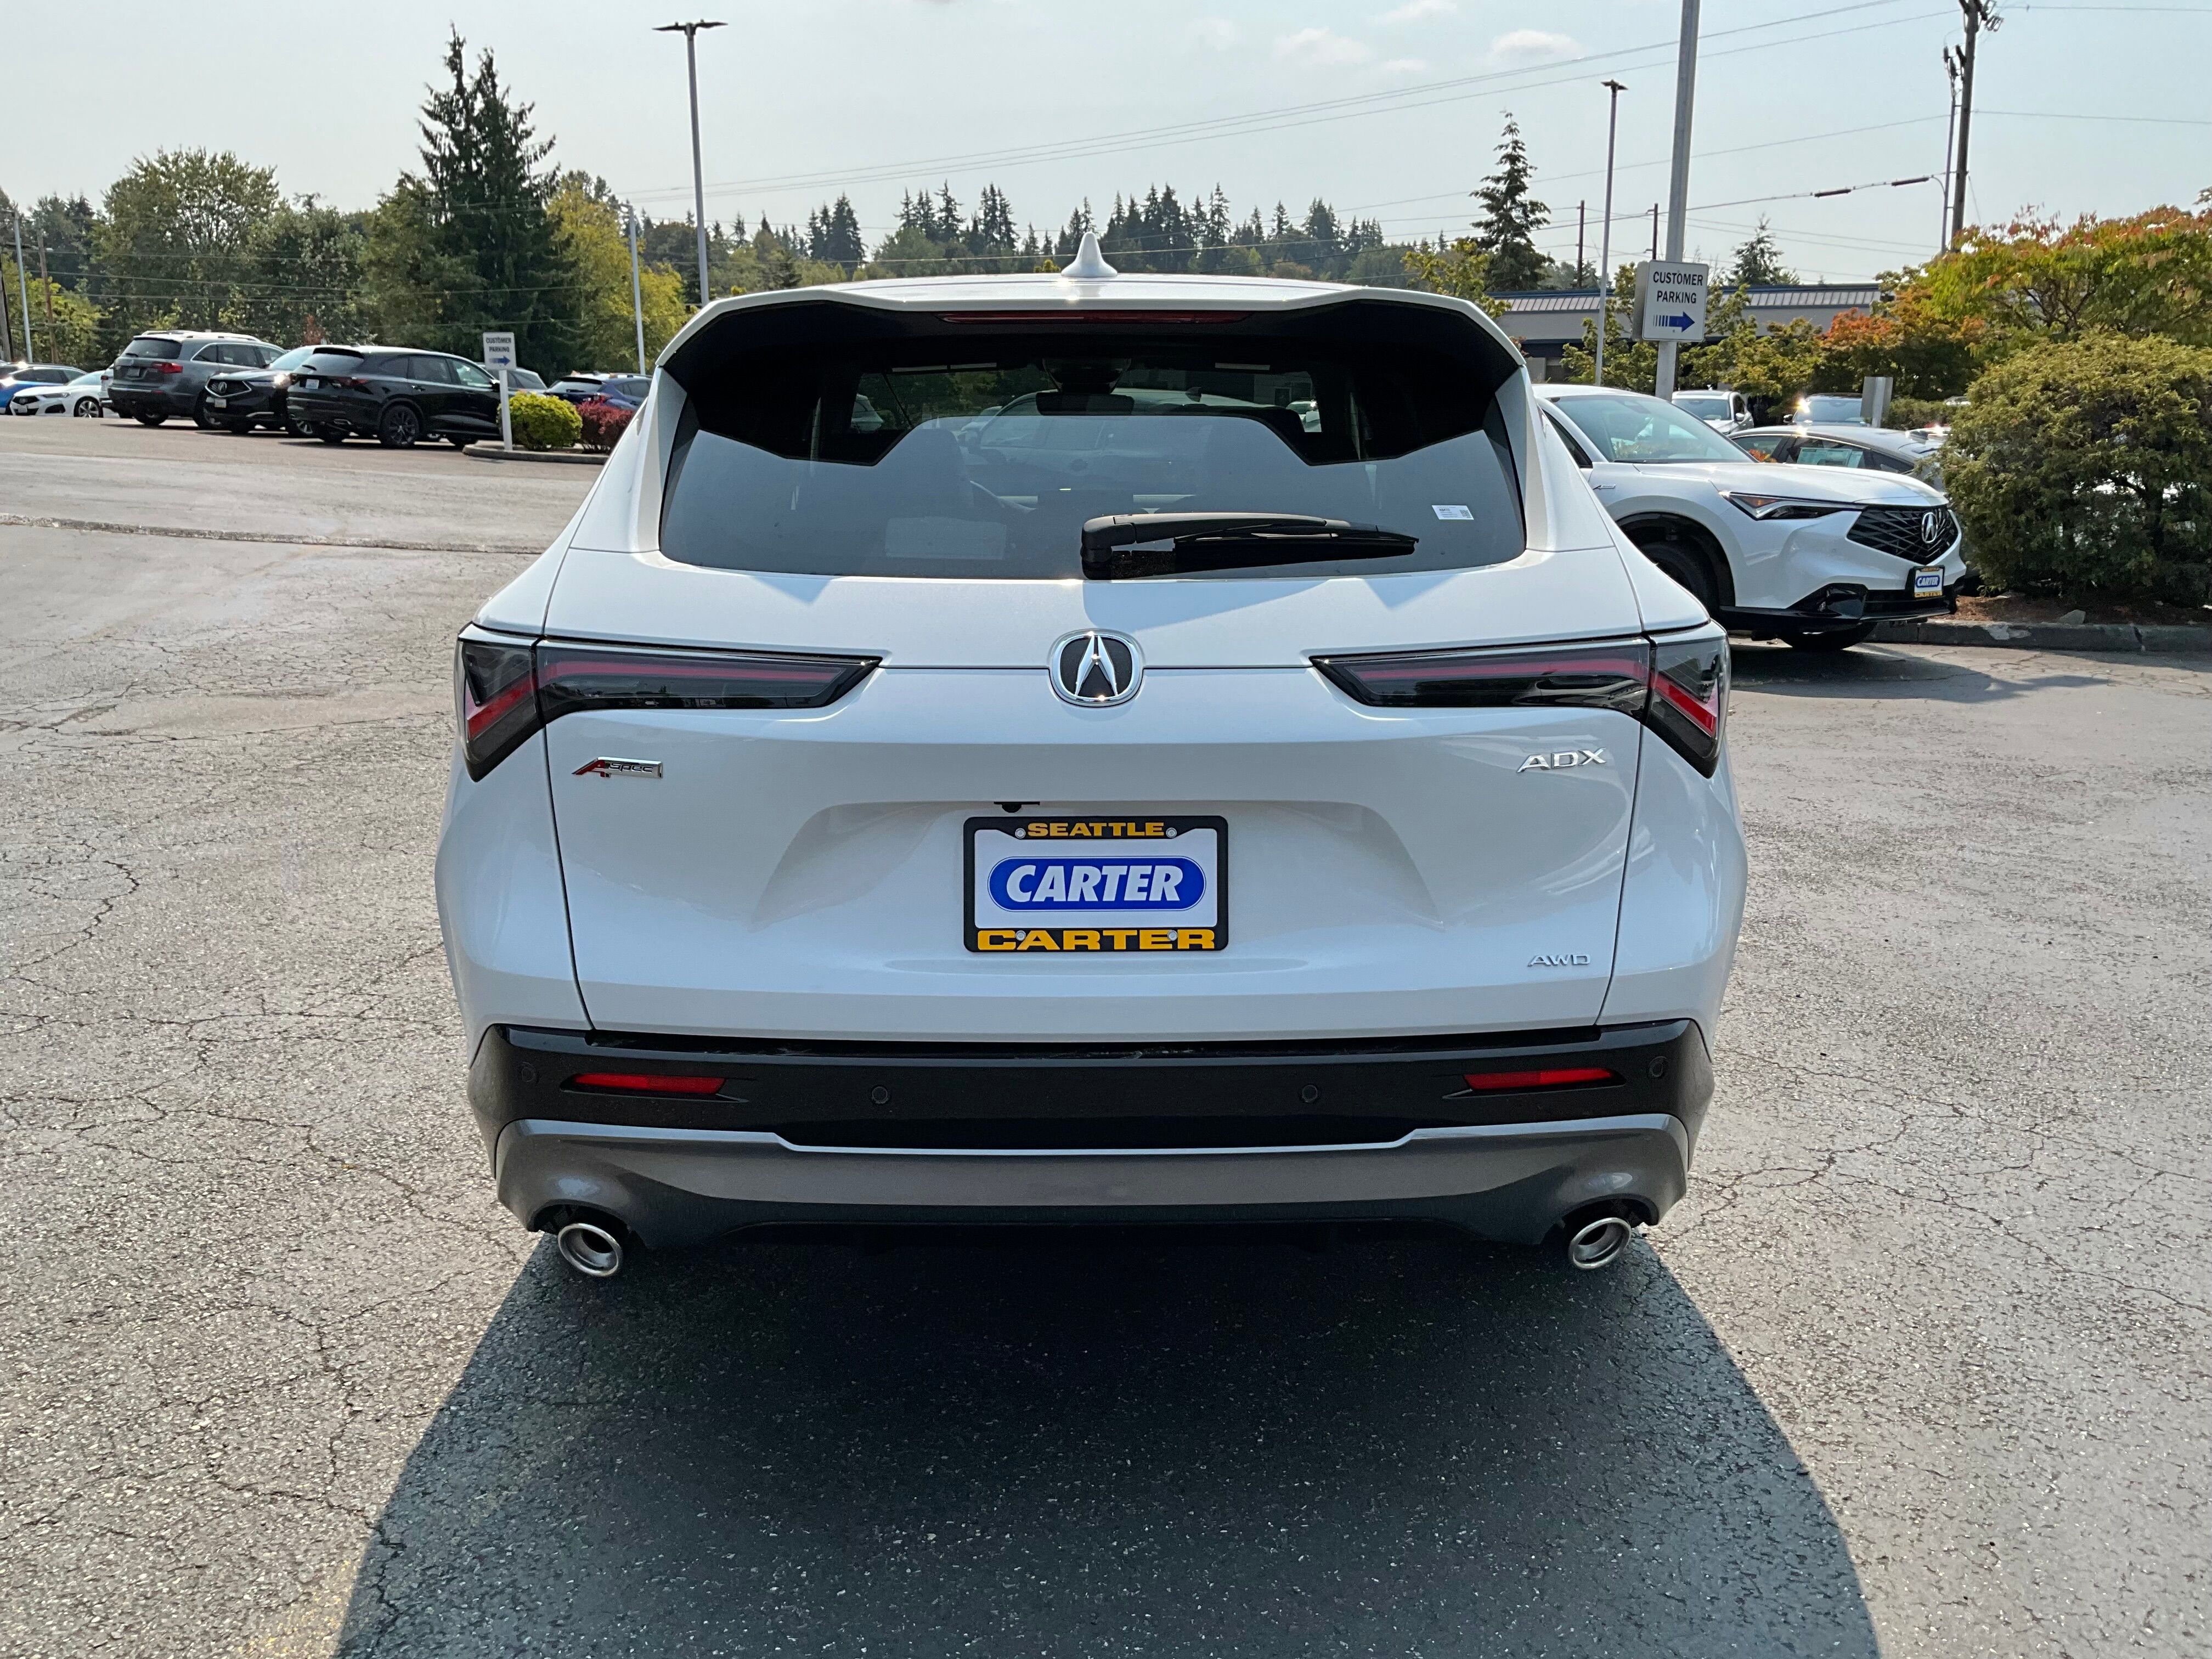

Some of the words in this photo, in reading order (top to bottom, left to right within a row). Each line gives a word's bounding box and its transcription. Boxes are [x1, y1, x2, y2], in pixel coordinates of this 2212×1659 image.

[1653, 272, 1703, 286] CUSTOMER
[1657, 290, 1696, 303] PARKING
[1917, 577, 1938, 586] CARTER
[1517, 747, 1606, 773] ADX
[1027, 822, 1164, 837] SEATTLE
[1006, 865, 1183, 902] CARTER
[978, 929, 1215, 950] CARTER
[1527, 953, 1590, 967] AWD
